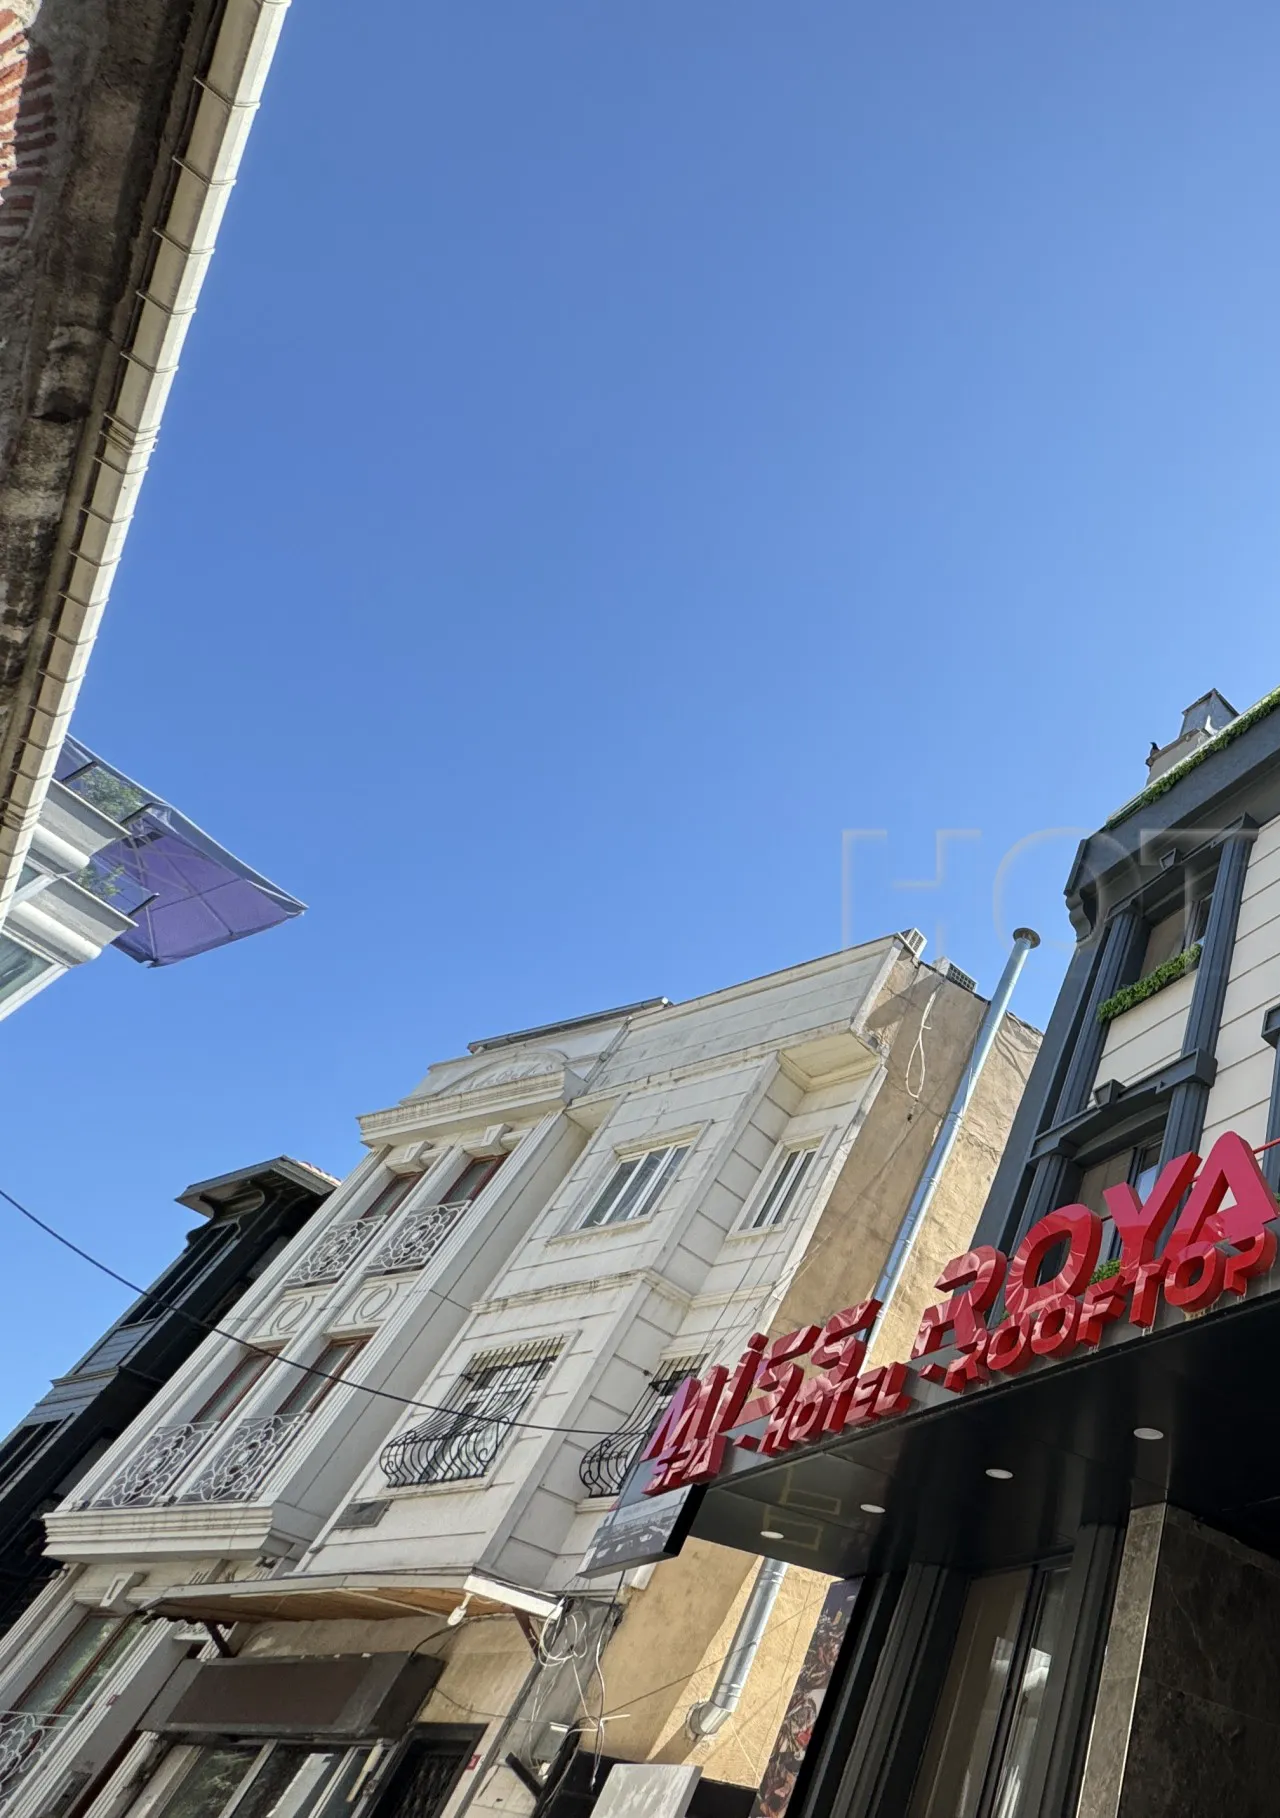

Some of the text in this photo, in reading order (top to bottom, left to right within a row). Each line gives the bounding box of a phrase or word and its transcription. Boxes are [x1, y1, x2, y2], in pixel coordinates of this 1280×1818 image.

[641, 1433, 730, 1497] SPA
[756, 1360, 914, 1458] HOTEL
[943, 1225, 1279, 1394] ROOFTOP
